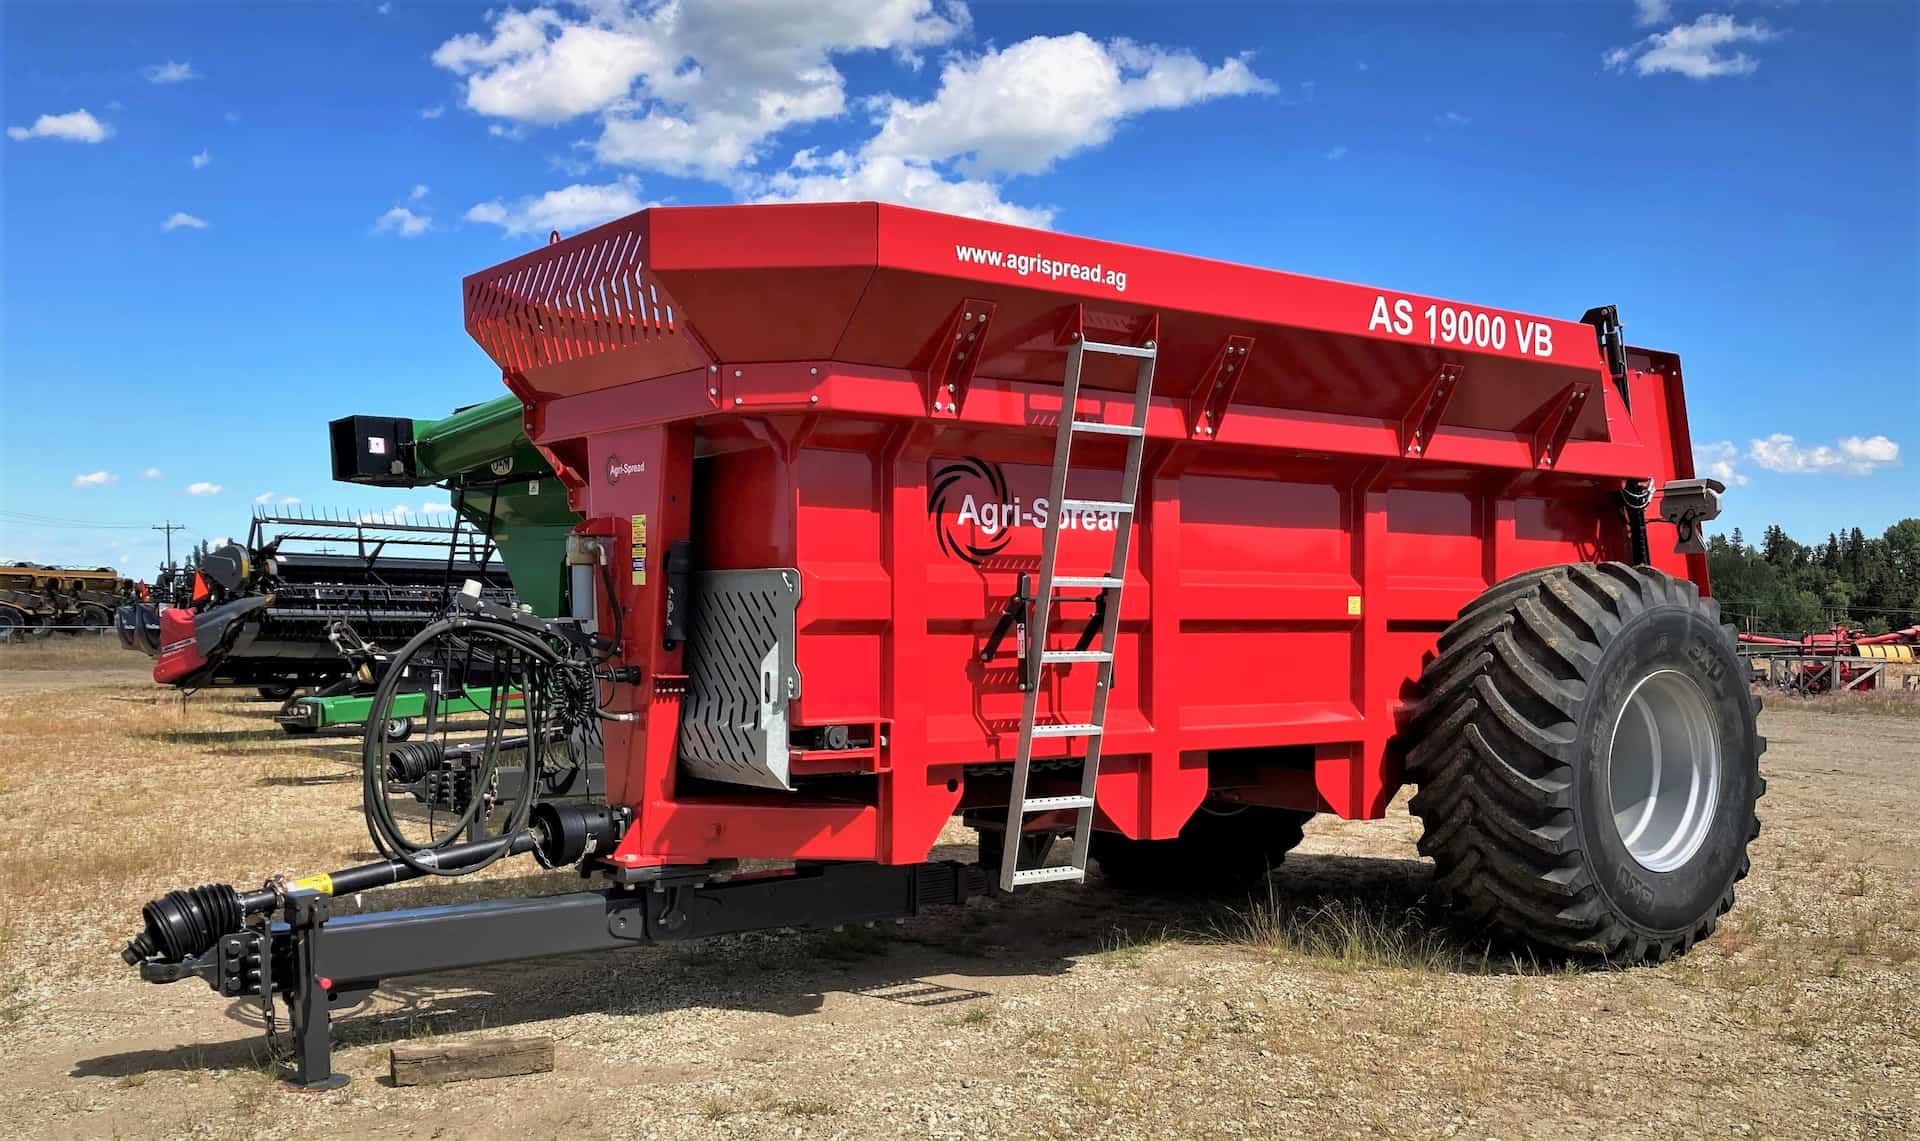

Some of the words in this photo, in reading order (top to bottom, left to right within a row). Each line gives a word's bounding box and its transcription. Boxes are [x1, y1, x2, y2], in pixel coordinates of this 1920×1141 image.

[956, 244, 1127, 292] www.agrispread.ag
[1368, 296, 1413, 335] AS
[1424, 305, 1507, 350] 19000
[1515, 319, 1553, 357] VB
[609, 461, 645, 477] Agri-Spread
[957, 494, 1119, 534] Agri-Srea
